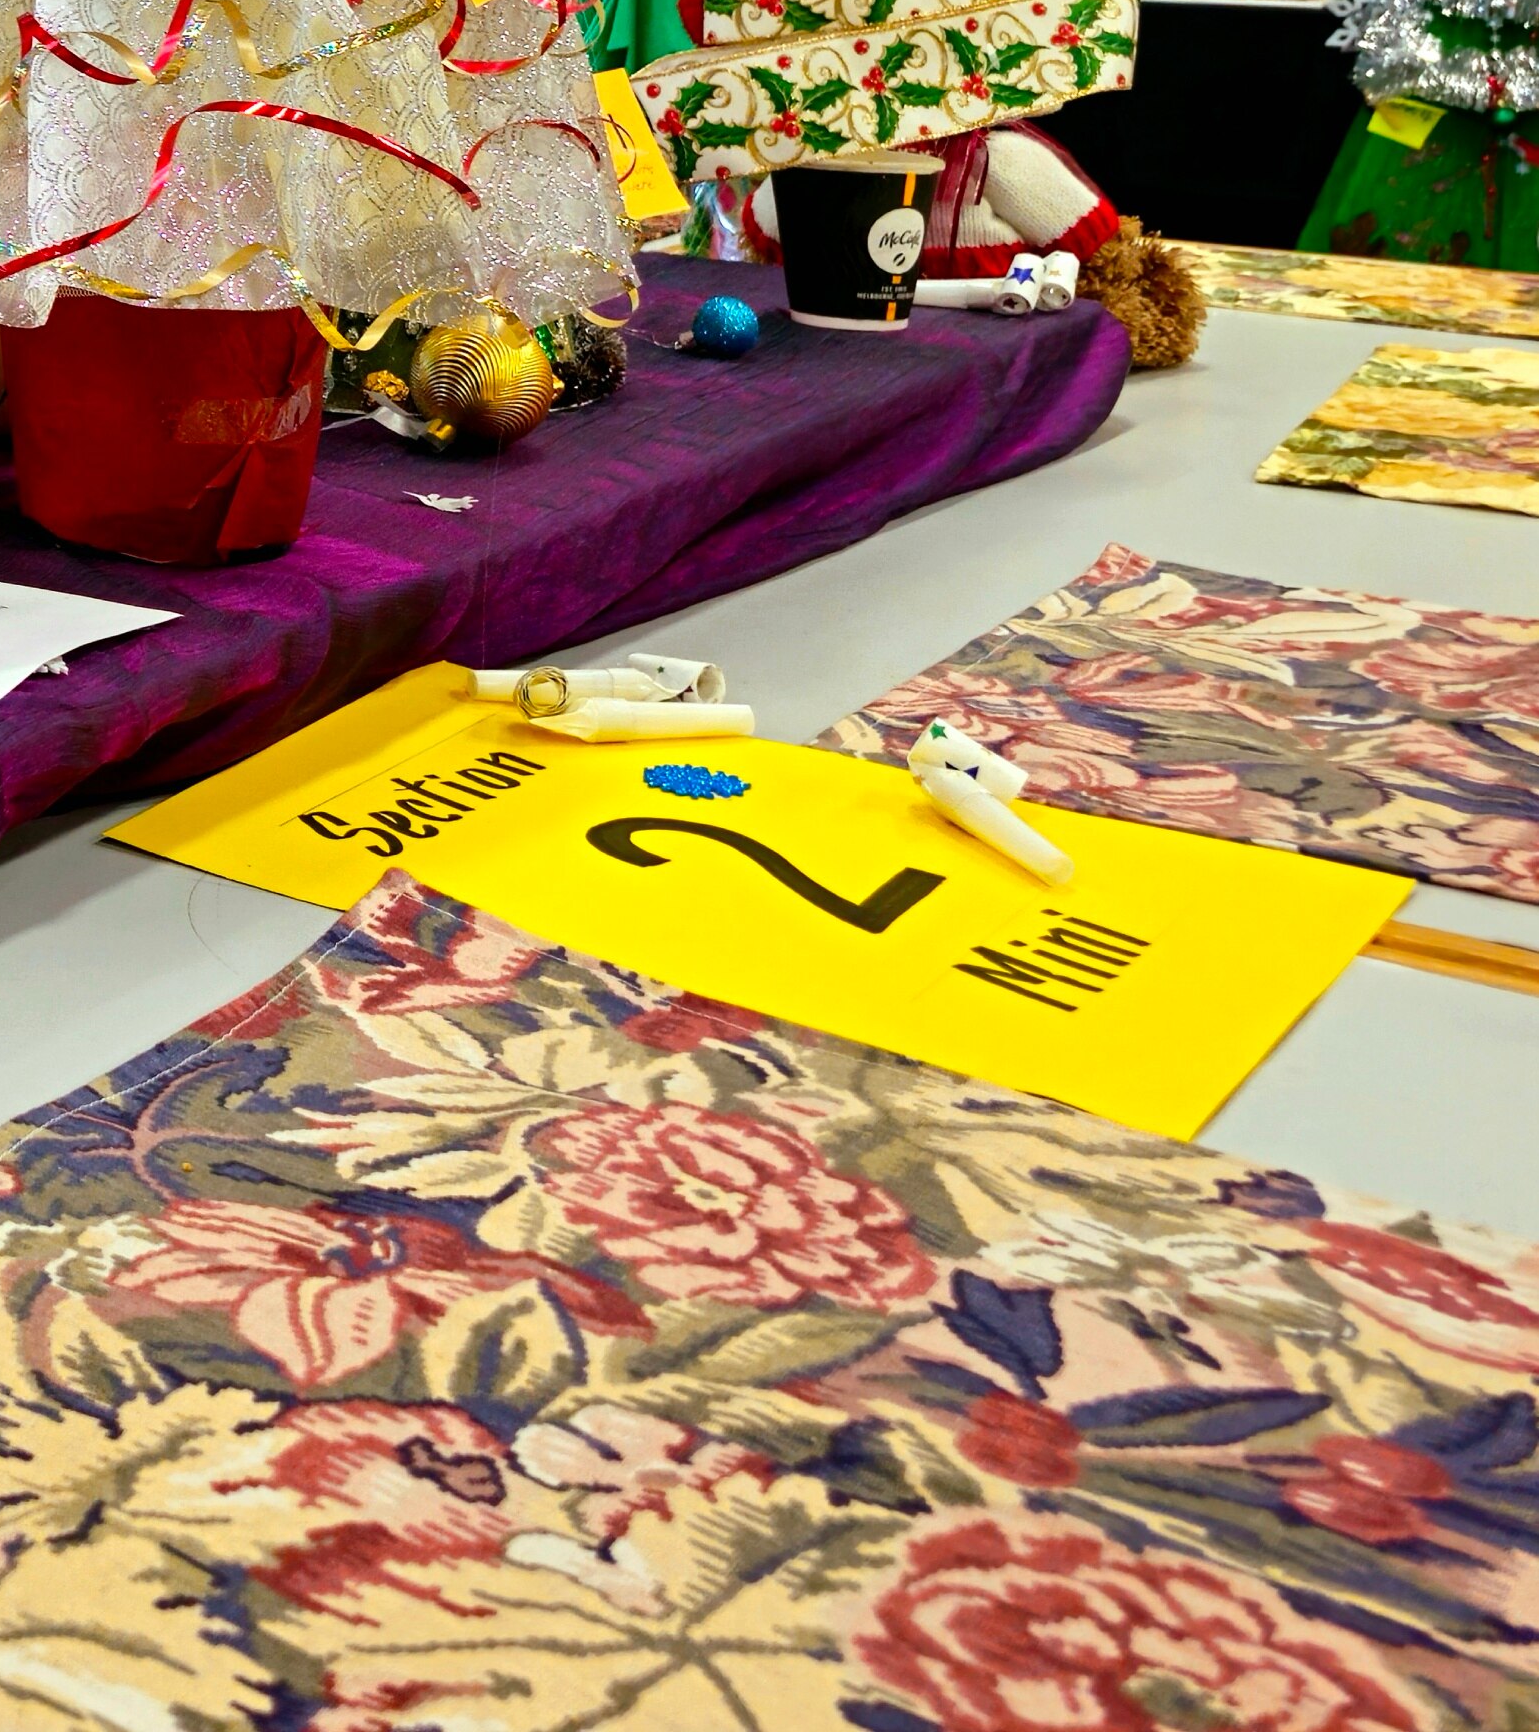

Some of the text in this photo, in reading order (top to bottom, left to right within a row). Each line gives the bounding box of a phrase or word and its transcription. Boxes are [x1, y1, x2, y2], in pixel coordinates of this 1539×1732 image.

[299, 749, 548, 860] Section
[585, 816, 946, 935] 2
[954, 909, 1153, 1014] Mini
